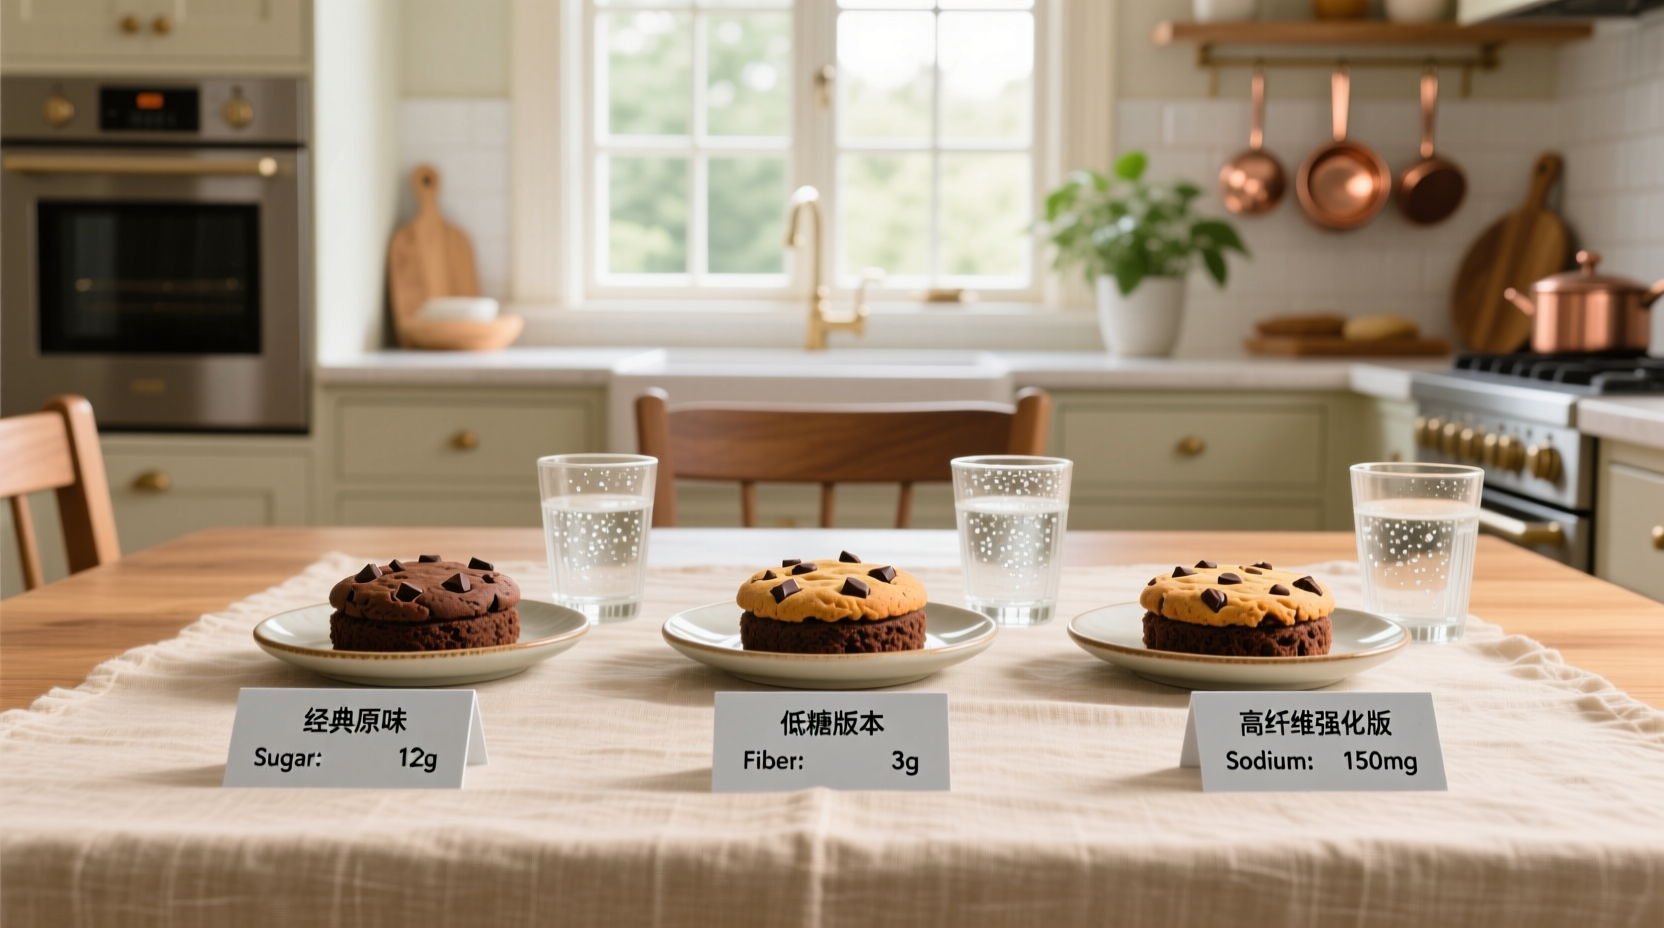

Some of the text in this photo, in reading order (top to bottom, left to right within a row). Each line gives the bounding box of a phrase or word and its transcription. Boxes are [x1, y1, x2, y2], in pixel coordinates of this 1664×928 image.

[302, 705, 408, 735] 经典原味
[779, 708, 885, 737] 低糖版本
[1239, 708, 1393, 737] 高纤维强化版
[253, 746, 438, 774] Sugar: 12g
[743, 749, 919, 777] Fiber: 3g
[1225, 749, 1418, 777] Sodium: 150mg
